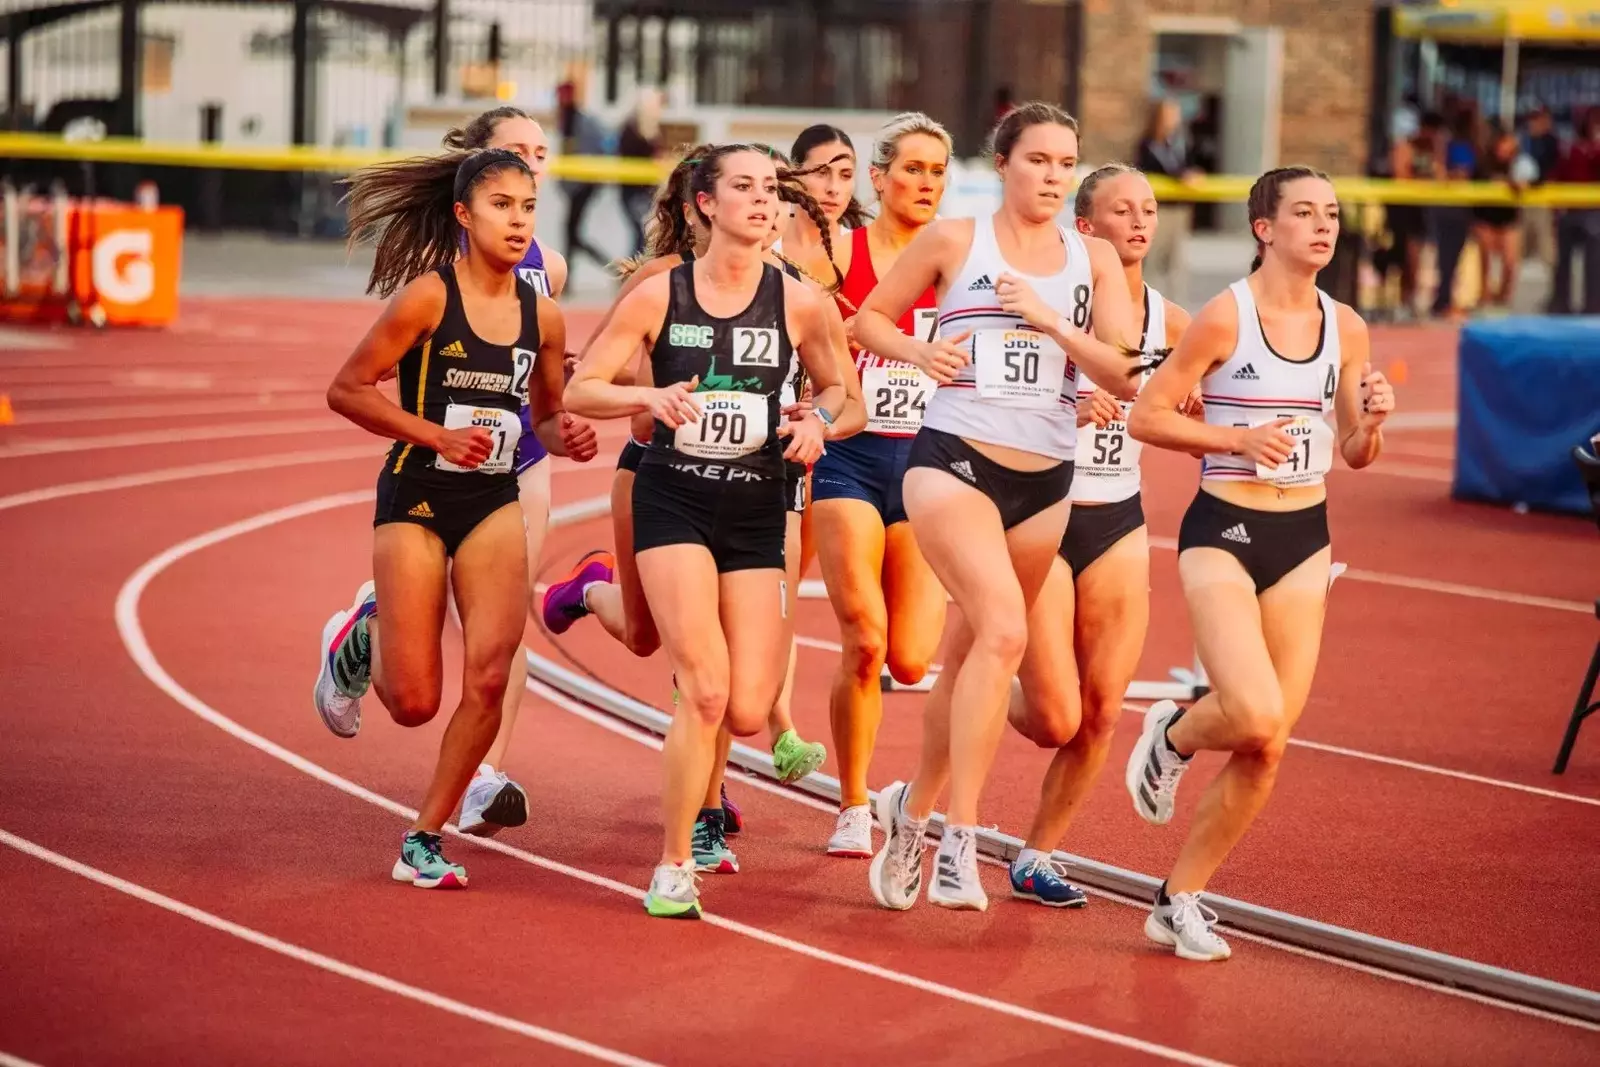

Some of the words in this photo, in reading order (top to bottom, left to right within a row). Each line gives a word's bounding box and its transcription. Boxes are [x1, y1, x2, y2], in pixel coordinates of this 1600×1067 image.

[93, 230, 155, 305] G
[1073, 284, 1090, 328] 8
[669, 323, 714, 348] SBC
[921, 311, 939, 343] 7
[1004, 332, 1040, 349] SBC
[740, 330, 772, 364] 22
[442, 368, 512, 393] SOUTHERN
[514, 353, 532, 395] 2
[887, 370, 920, 387] SBC
[1004, 352, 1039, 384] 50
[705, 393, 743, 410] SBC
[875, 387, 926, 419] 224
[471, 409, 502, 427] SBC
[700, 412, 747, 444] 190
[1092, 433, 1123, 465] 52
[950, 462, 977, 483] adidas
[1221, 531, 1251, 544] adidas
